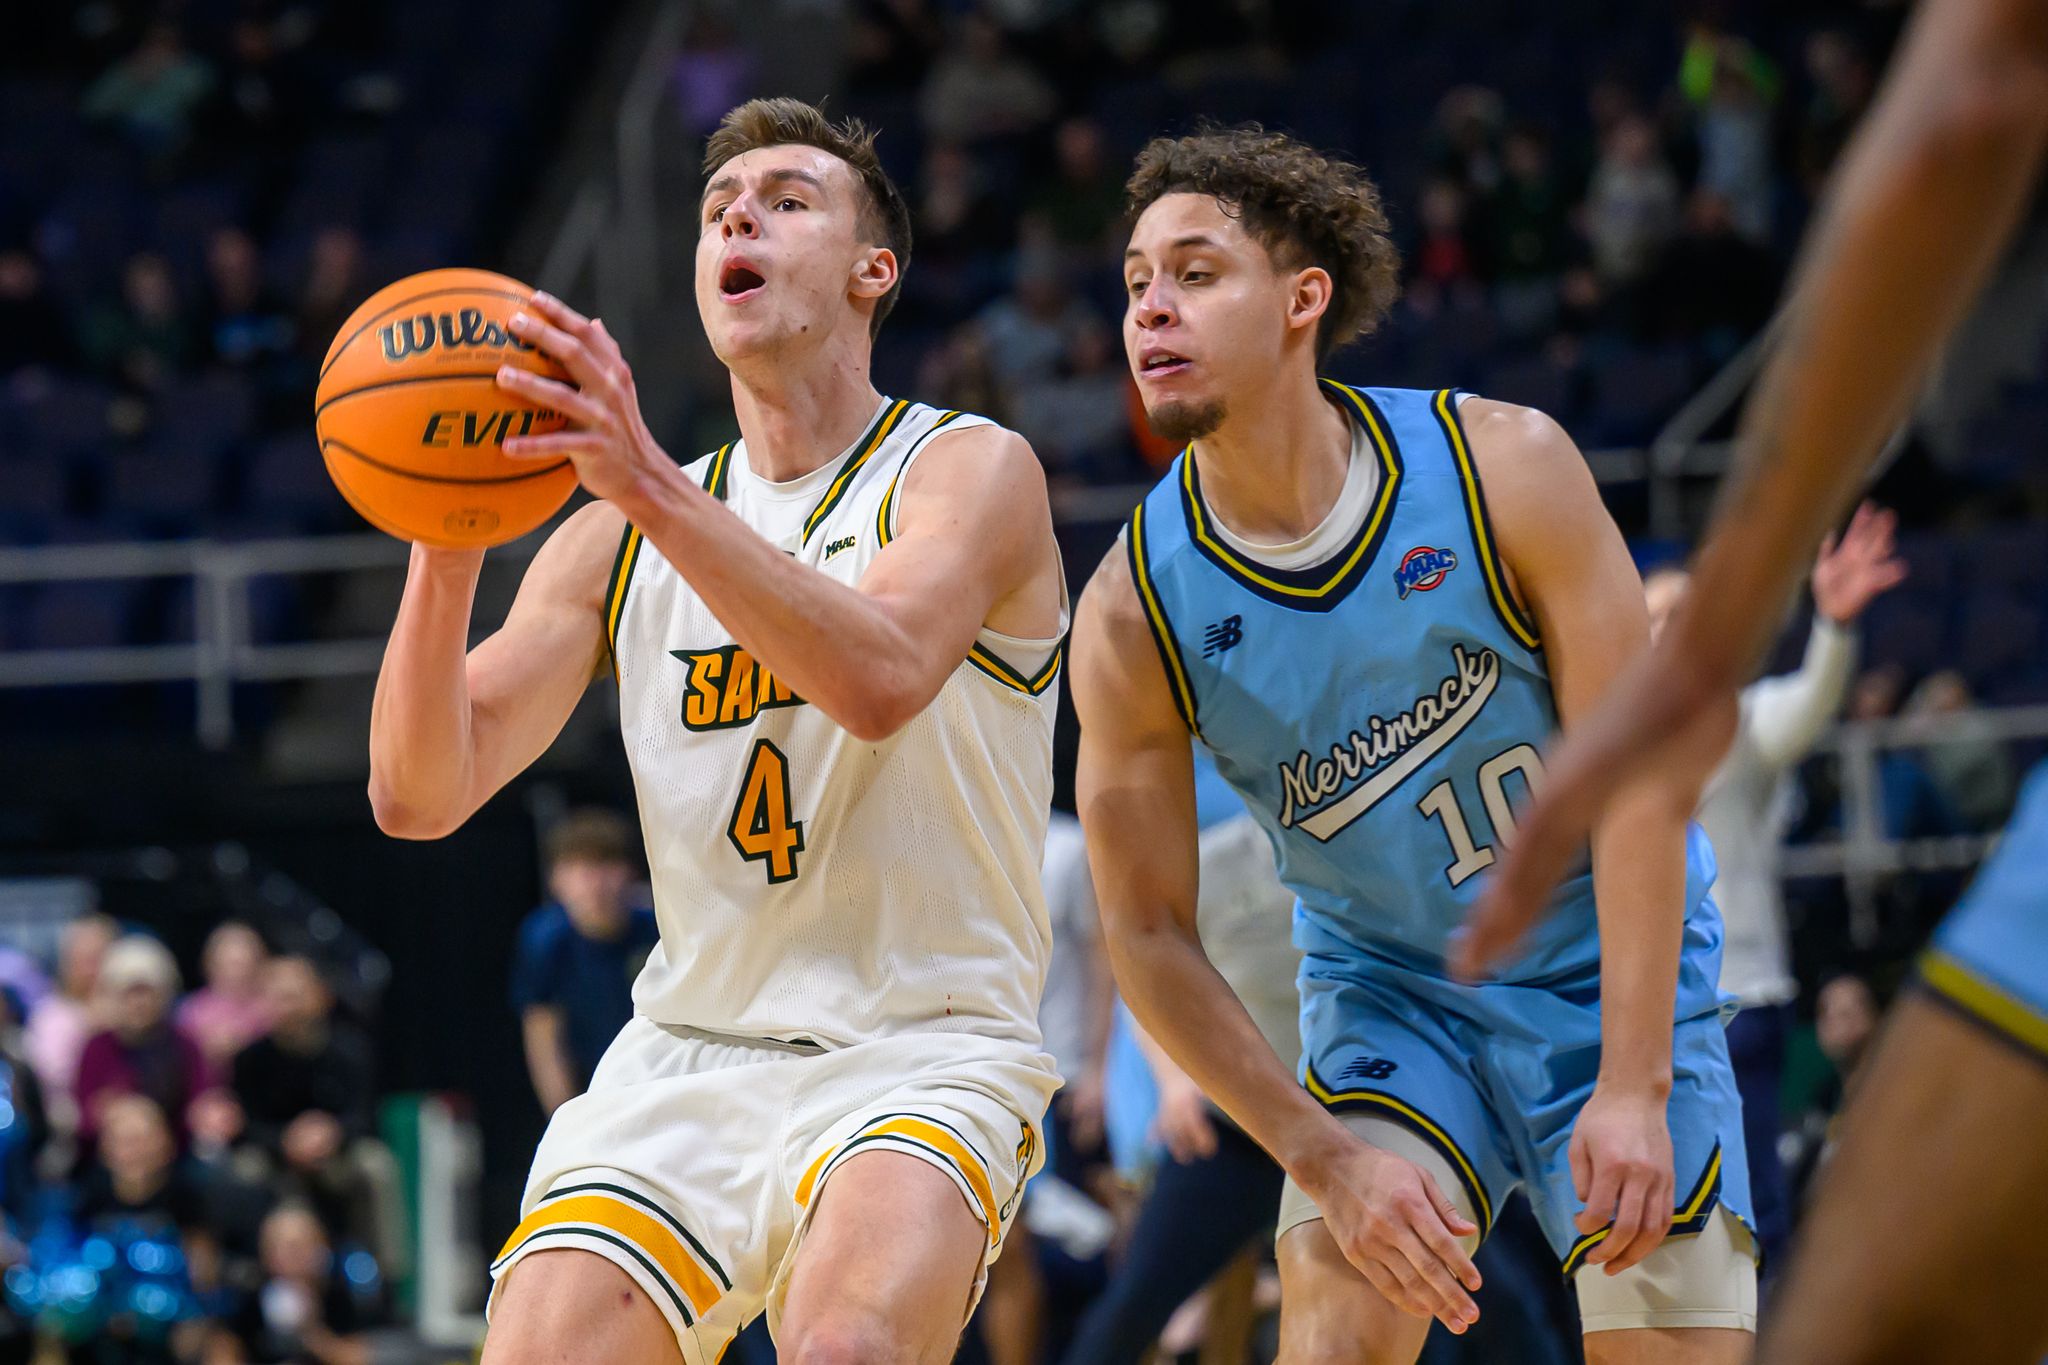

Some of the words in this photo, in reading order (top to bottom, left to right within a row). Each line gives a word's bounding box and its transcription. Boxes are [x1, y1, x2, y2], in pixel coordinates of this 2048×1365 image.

[421, 410, 534, 448] EVO
[825, 535, 856, 561] MAAC
[1393, 548, 1457, 600] MAAC
[1279, 643, 1500, 829] Merrimack
[727, 738, 805, 885] 4
[1416, 742, 1548, 890] 10
